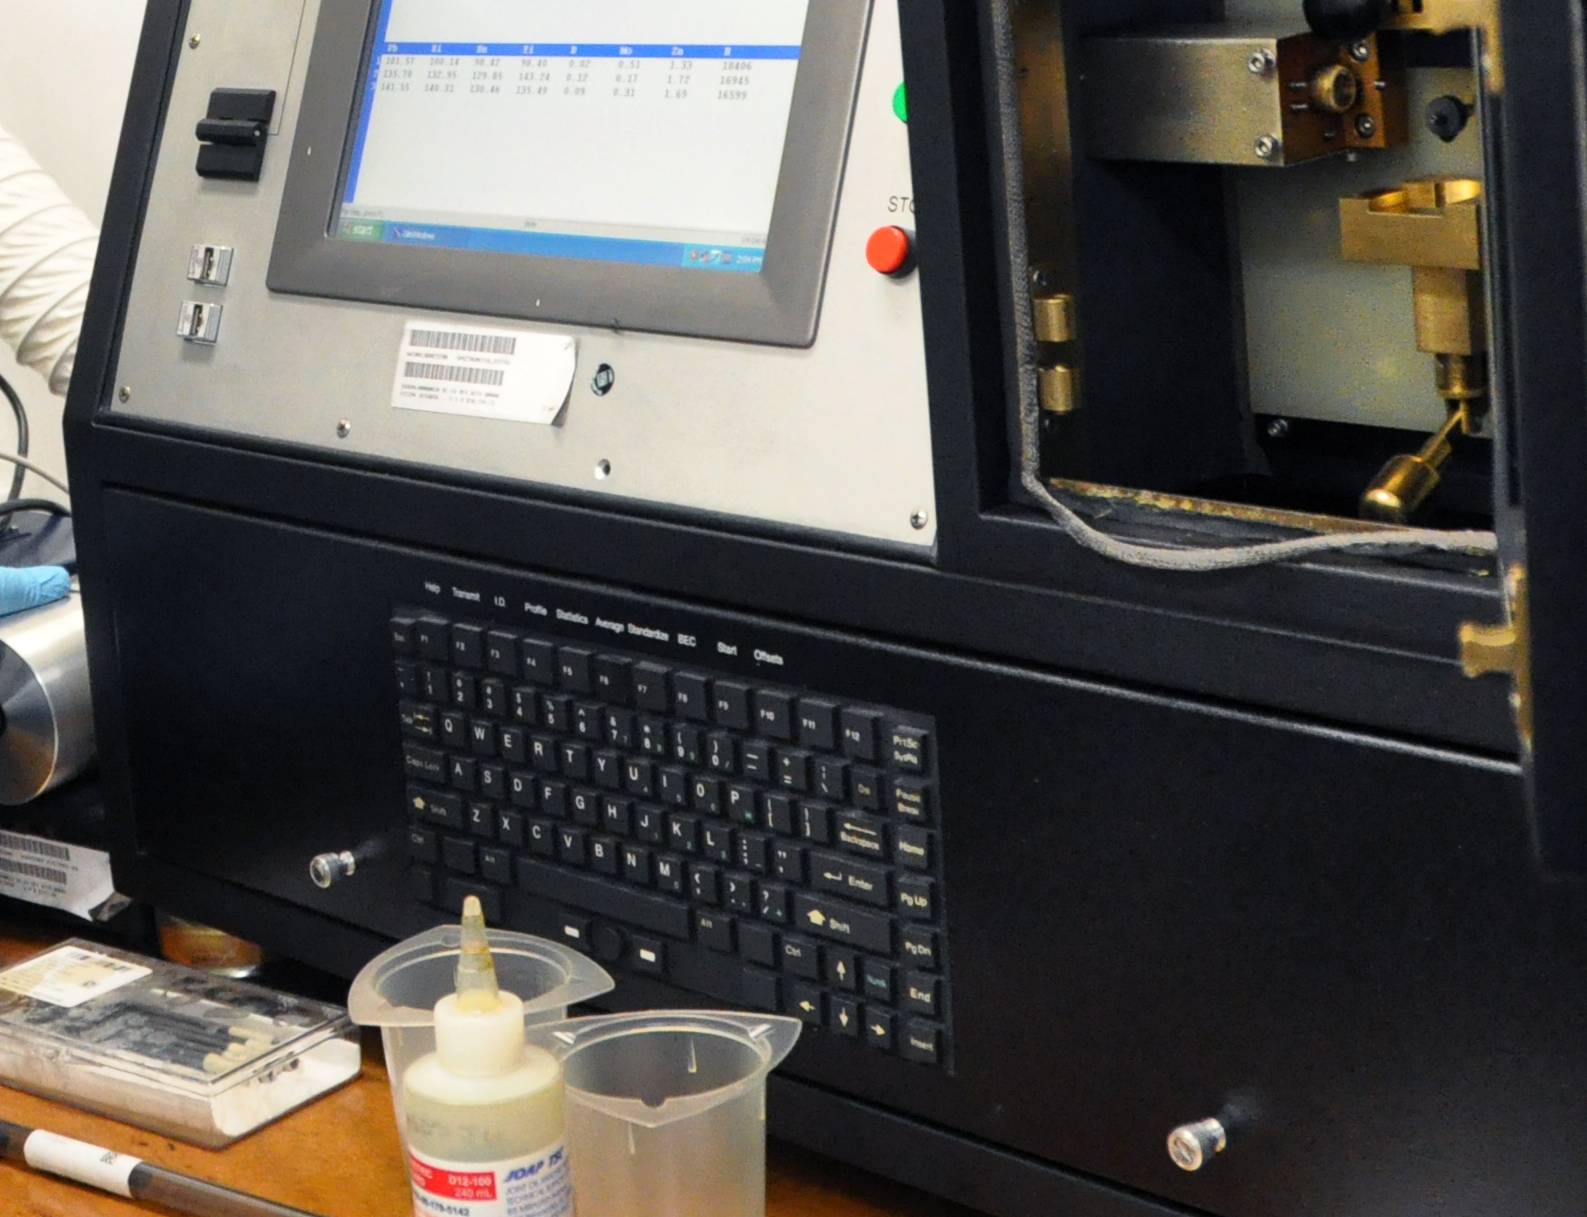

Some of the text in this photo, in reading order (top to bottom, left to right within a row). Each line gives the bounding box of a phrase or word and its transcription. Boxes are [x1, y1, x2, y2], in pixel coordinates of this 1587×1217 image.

[353, 225, 374, 236] start
[420, 634, 429, 644] F1
[456, 641, 466, 651] F2
[491, 648, 500, 659] F3
[527, 657, 537, 667] F4
[563, 665, 573, 676] F5
[599, 675, 609, 686] F6
[638, 684, 648, 694] F7
[678, 692, 688, 704] F8
[718, 700, 729, 711] F9
[760, 709, 775, 721] F10
[444, 718, 453, 733] Q
[802, 718, 816, 730] F11
[474, 726, 486, 741] W
[504, 733, 512, 748] E
[845, 728, 861, 742] F12
[534, 741, 544, 756] R
[566, 749, 574, 763] T
[454, 762, 463, 776] A
[597, 757, 606, 772] Y
[483, 770, 492, 784] S
[628, 766, 639, 781] U
[513, 778, 523, 792] D
[544, 786, 553, 800] F
[730, 790, 740, 804] P
[575, 795, 586, 810] G
[472, 809, 481, 823] Z
[607, 804, 617, 819] H
[501, 817, 511, 831] X
[640, 814, 649, 828] J
[532, 825, 542, 839] C
[672, 821, 682, 837] K
[563, 834, 573, 848] V
[706, 830, 715, 847] L
[594, 843, 604, 858] B
[898, 841, 925, 856] Home
[626, 852, 637, 868] N
[659, 861, 671, 877] M
[848, 875, 874, 891] Enter
[829, 918, 851, 934] Shift
[910, 988, 931, 1003] End
[448, 1175, 492, 1187] D12-100
[455, 1187, 475, 1198] 240
